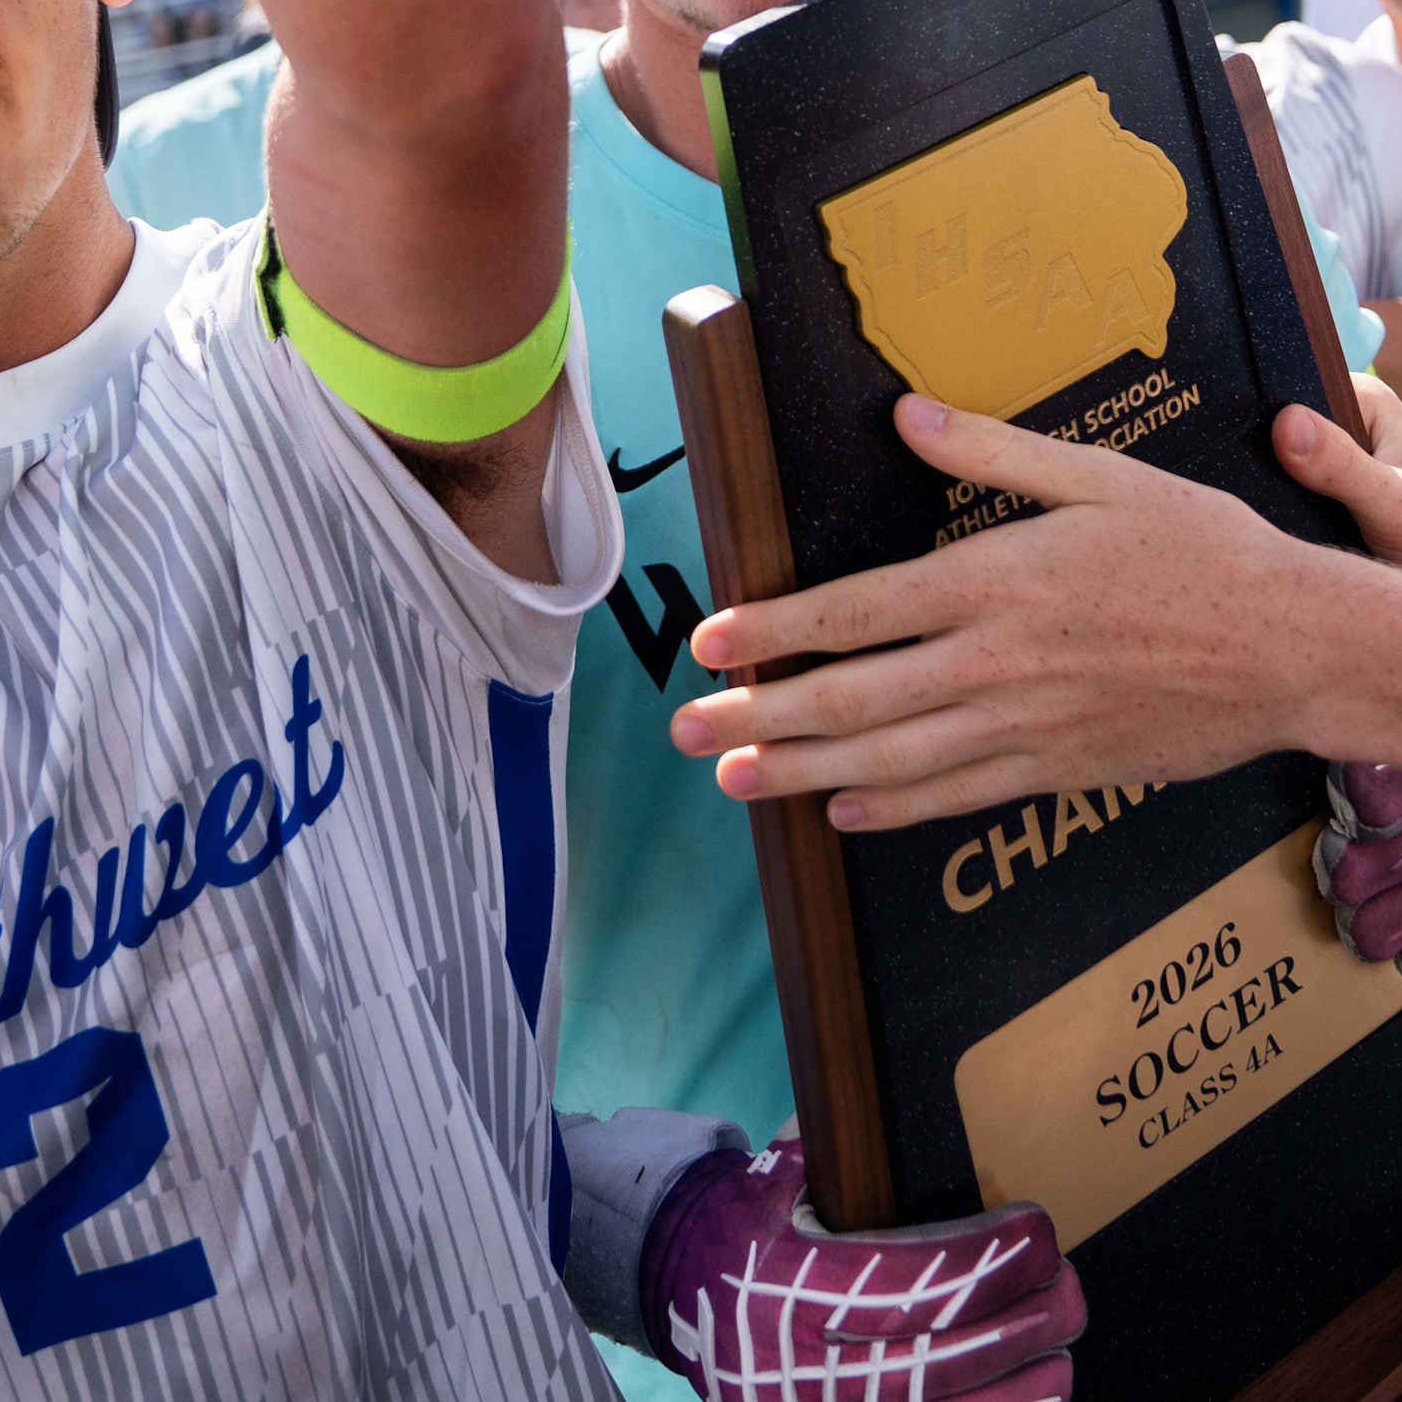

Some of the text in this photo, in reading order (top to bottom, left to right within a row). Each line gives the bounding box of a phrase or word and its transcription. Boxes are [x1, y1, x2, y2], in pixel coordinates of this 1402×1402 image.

[873, 198, 1156, 344] IHSAA
[935, 383, 1201, 550] ATHLET CIATION
[1083, 367, 1177, 433] SCHOOL
[942, 781, 1167, 914] CHAM
[1095, 955, 1303, 1127] SOCCER
[1130, 921, 1242, 1029] 2026
[1138, 1032, 1284, 1149] CLASS 4A
